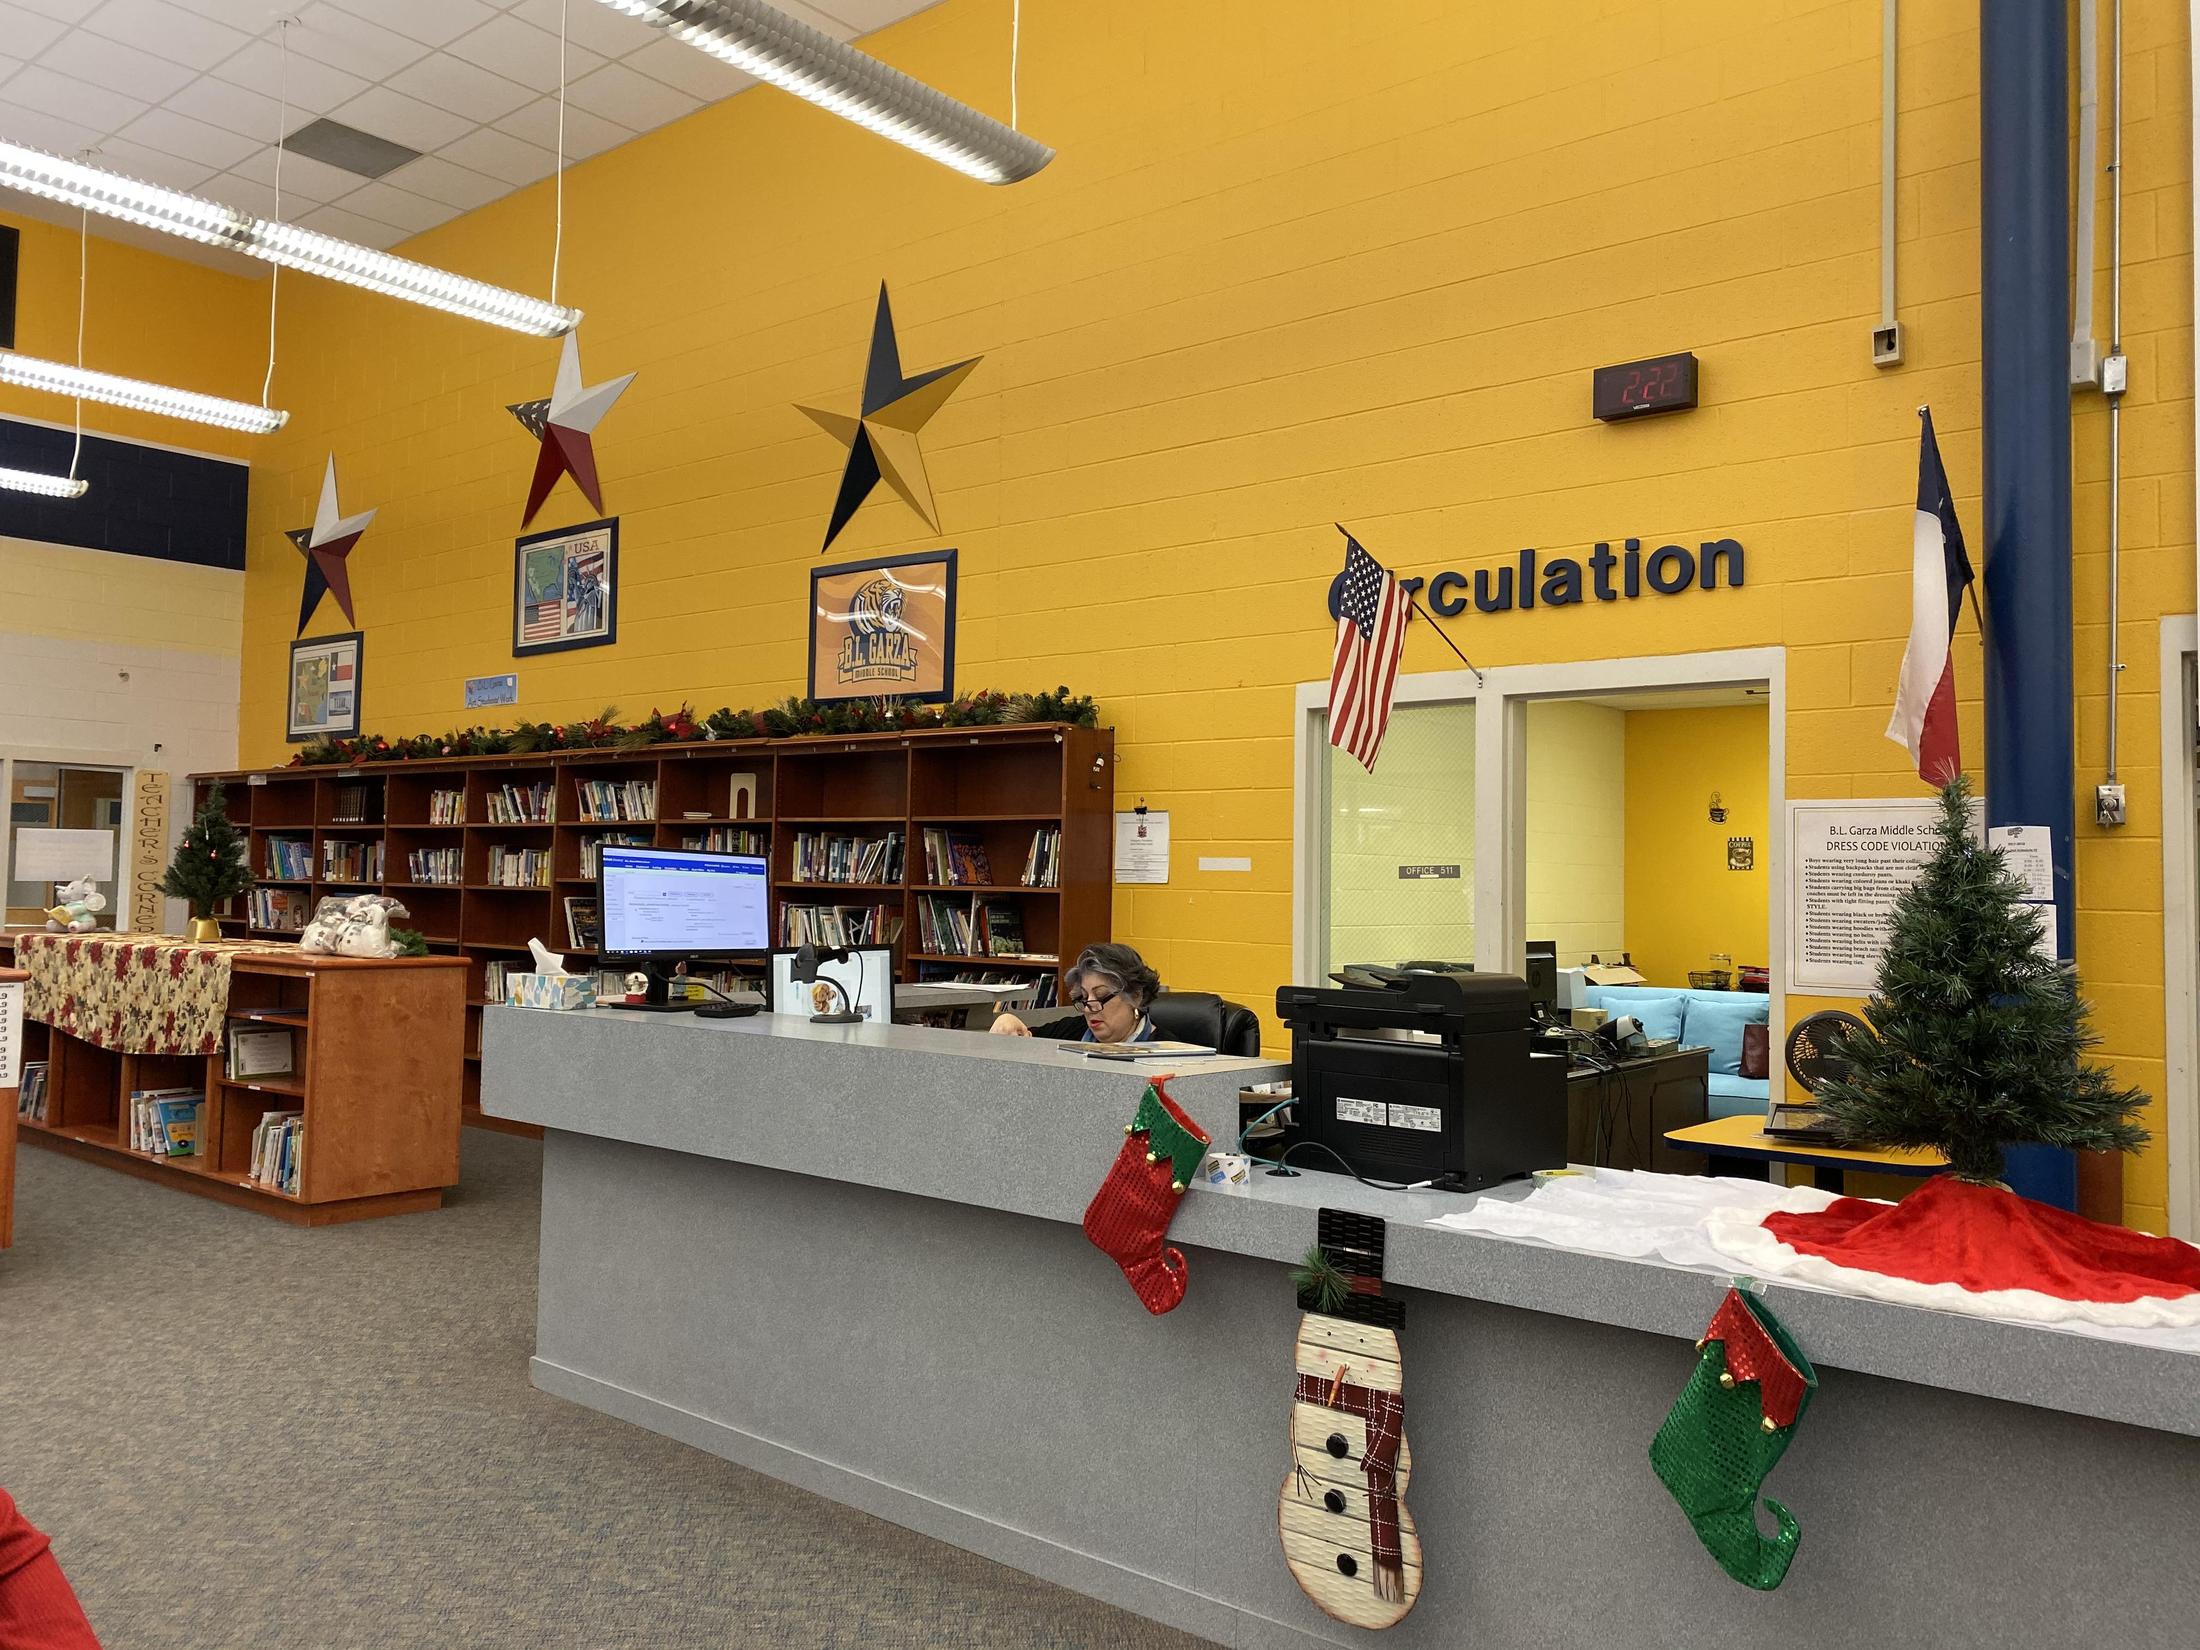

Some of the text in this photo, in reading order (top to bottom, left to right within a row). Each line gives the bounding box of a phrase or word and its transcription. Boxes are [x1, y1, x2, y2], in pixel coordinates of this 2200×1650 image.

[574, 540, 599, 554] USA
[1328, 537, 1744, 622] rculation
[868, 633, 911, 667] GARZA
[855, 667, 898, 678] MIDDLE SCHOOL
[1830, 826, 1847, 835] B.L.
[1849, 826, 1877, 835] Garza
[1880, 825, 1914, 835] Middle
[1827, 842, 1858, 851] DRESS
[1861, 842, 1889, 851] CODE
[1406, 866, 1453, 875] OFFICE 511
